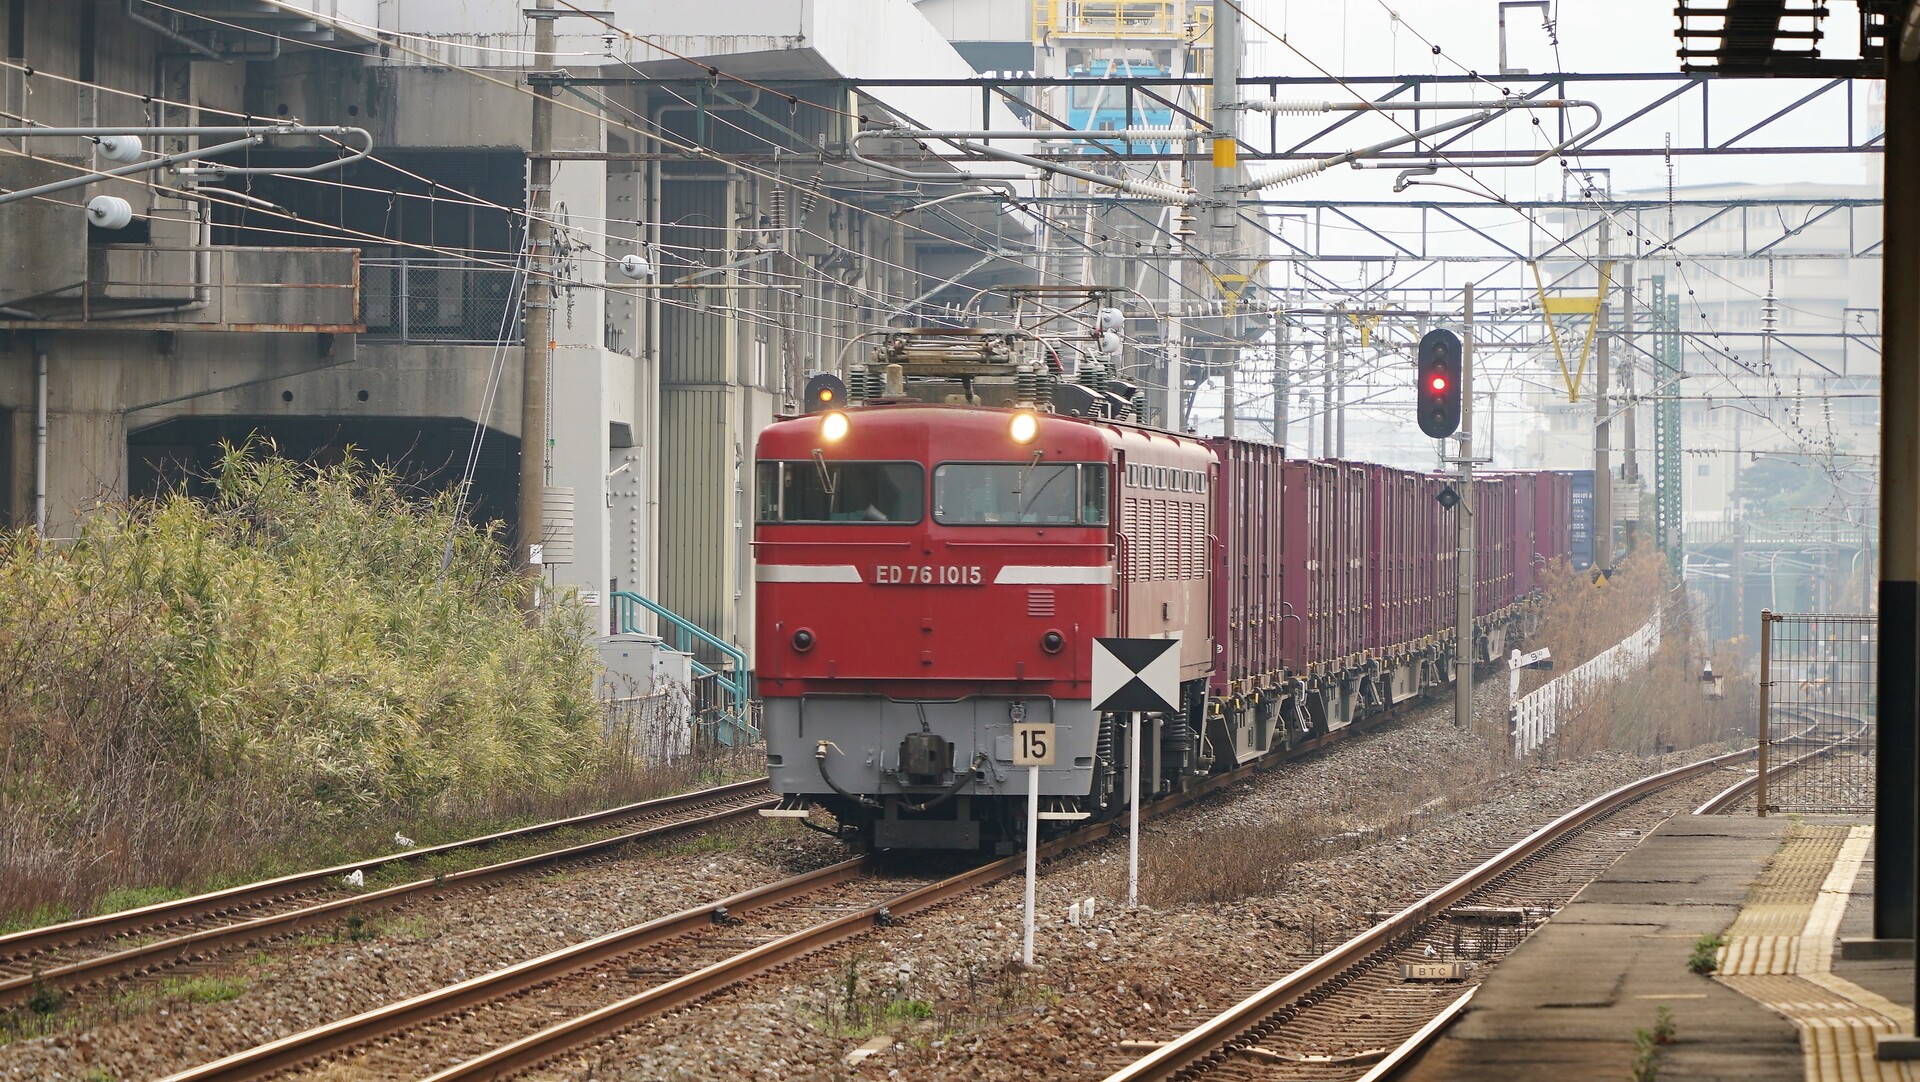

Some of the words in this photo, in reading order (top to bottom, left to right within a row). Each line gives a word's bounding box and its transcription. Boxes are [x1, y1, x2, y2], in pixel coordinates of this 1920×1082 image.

[876, 565, 902, 584] ED
[907, 565, 933, 584] 76
[940, 566, 981, 584] 1015
[1020, 730, 1046, 758] 15
[1418, 967, 1446, 976] BTC
